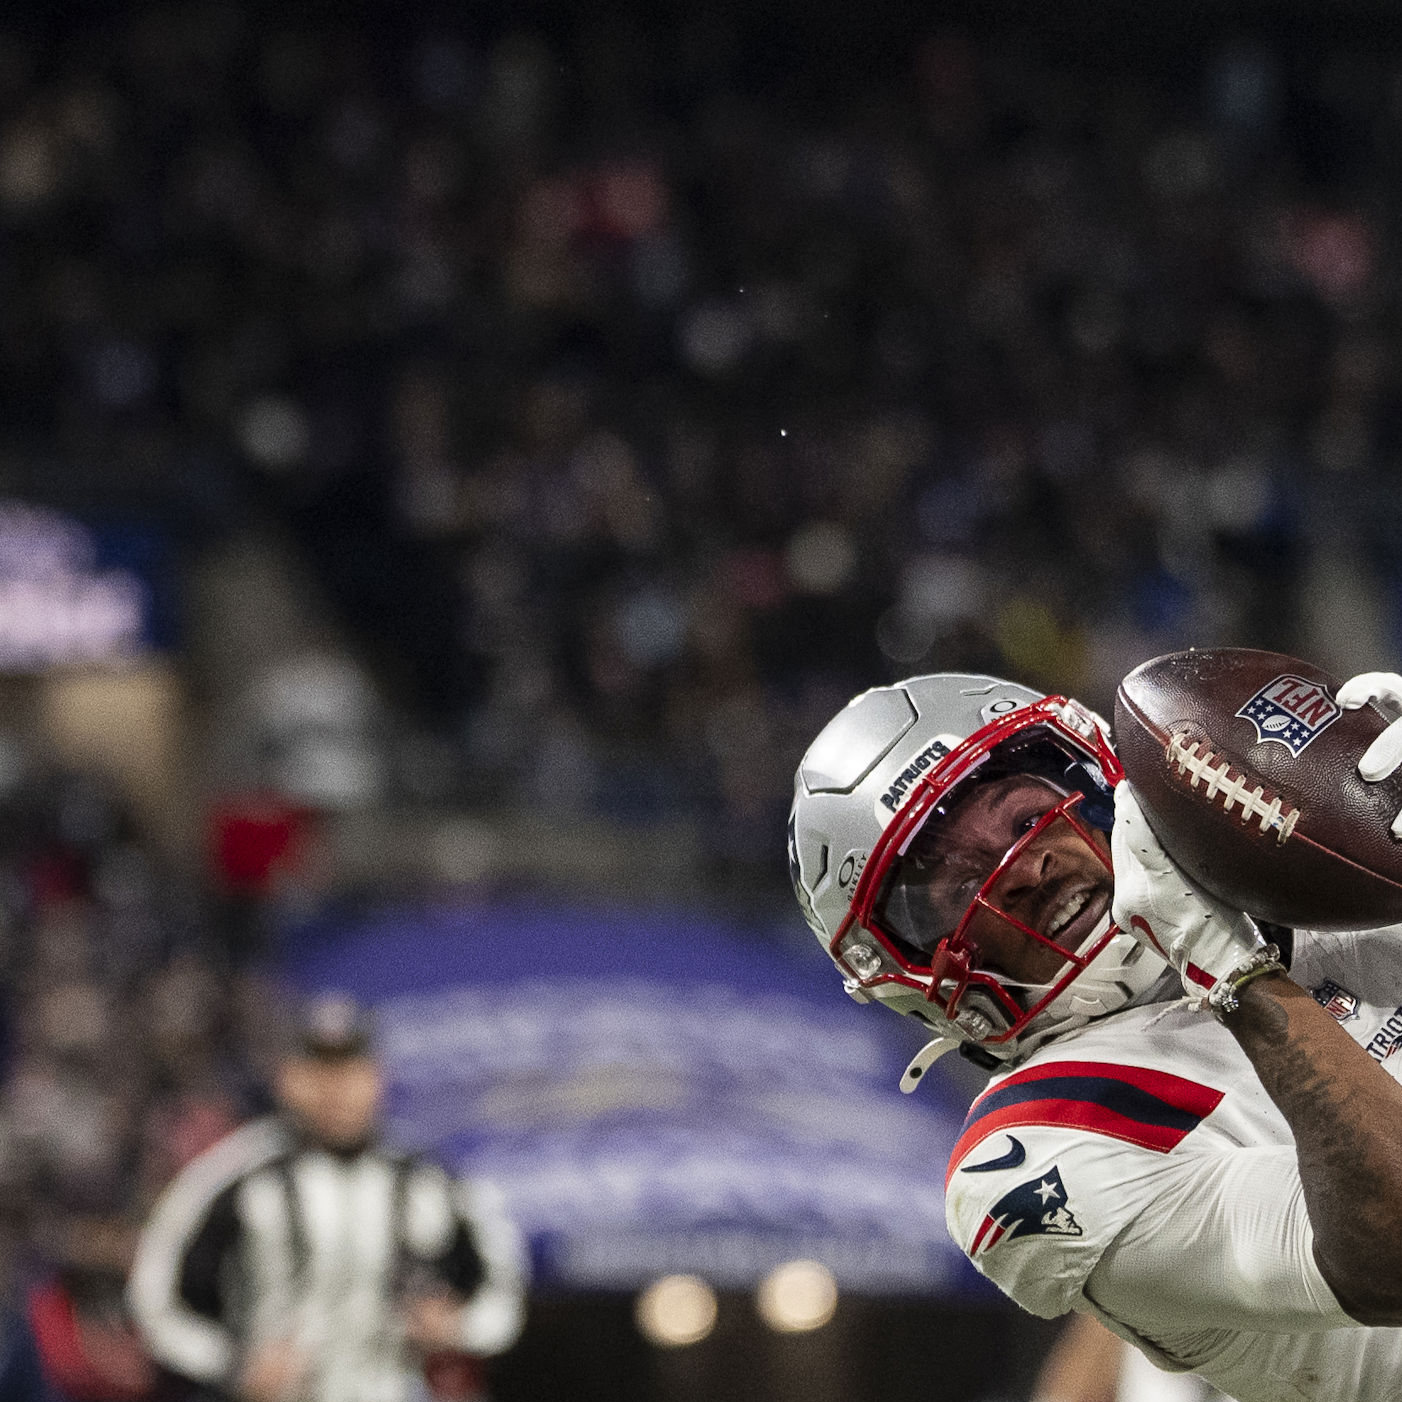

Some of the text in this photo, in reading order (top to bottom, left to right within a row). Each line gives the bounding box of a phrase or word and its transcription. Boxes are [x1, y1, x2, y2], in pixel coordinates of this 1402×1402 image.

[1273, 679, 1334, 727] NFL
[880, 740, 951, 813] PATRIOTS
[1325, 996, 1355, 1018] NFL
